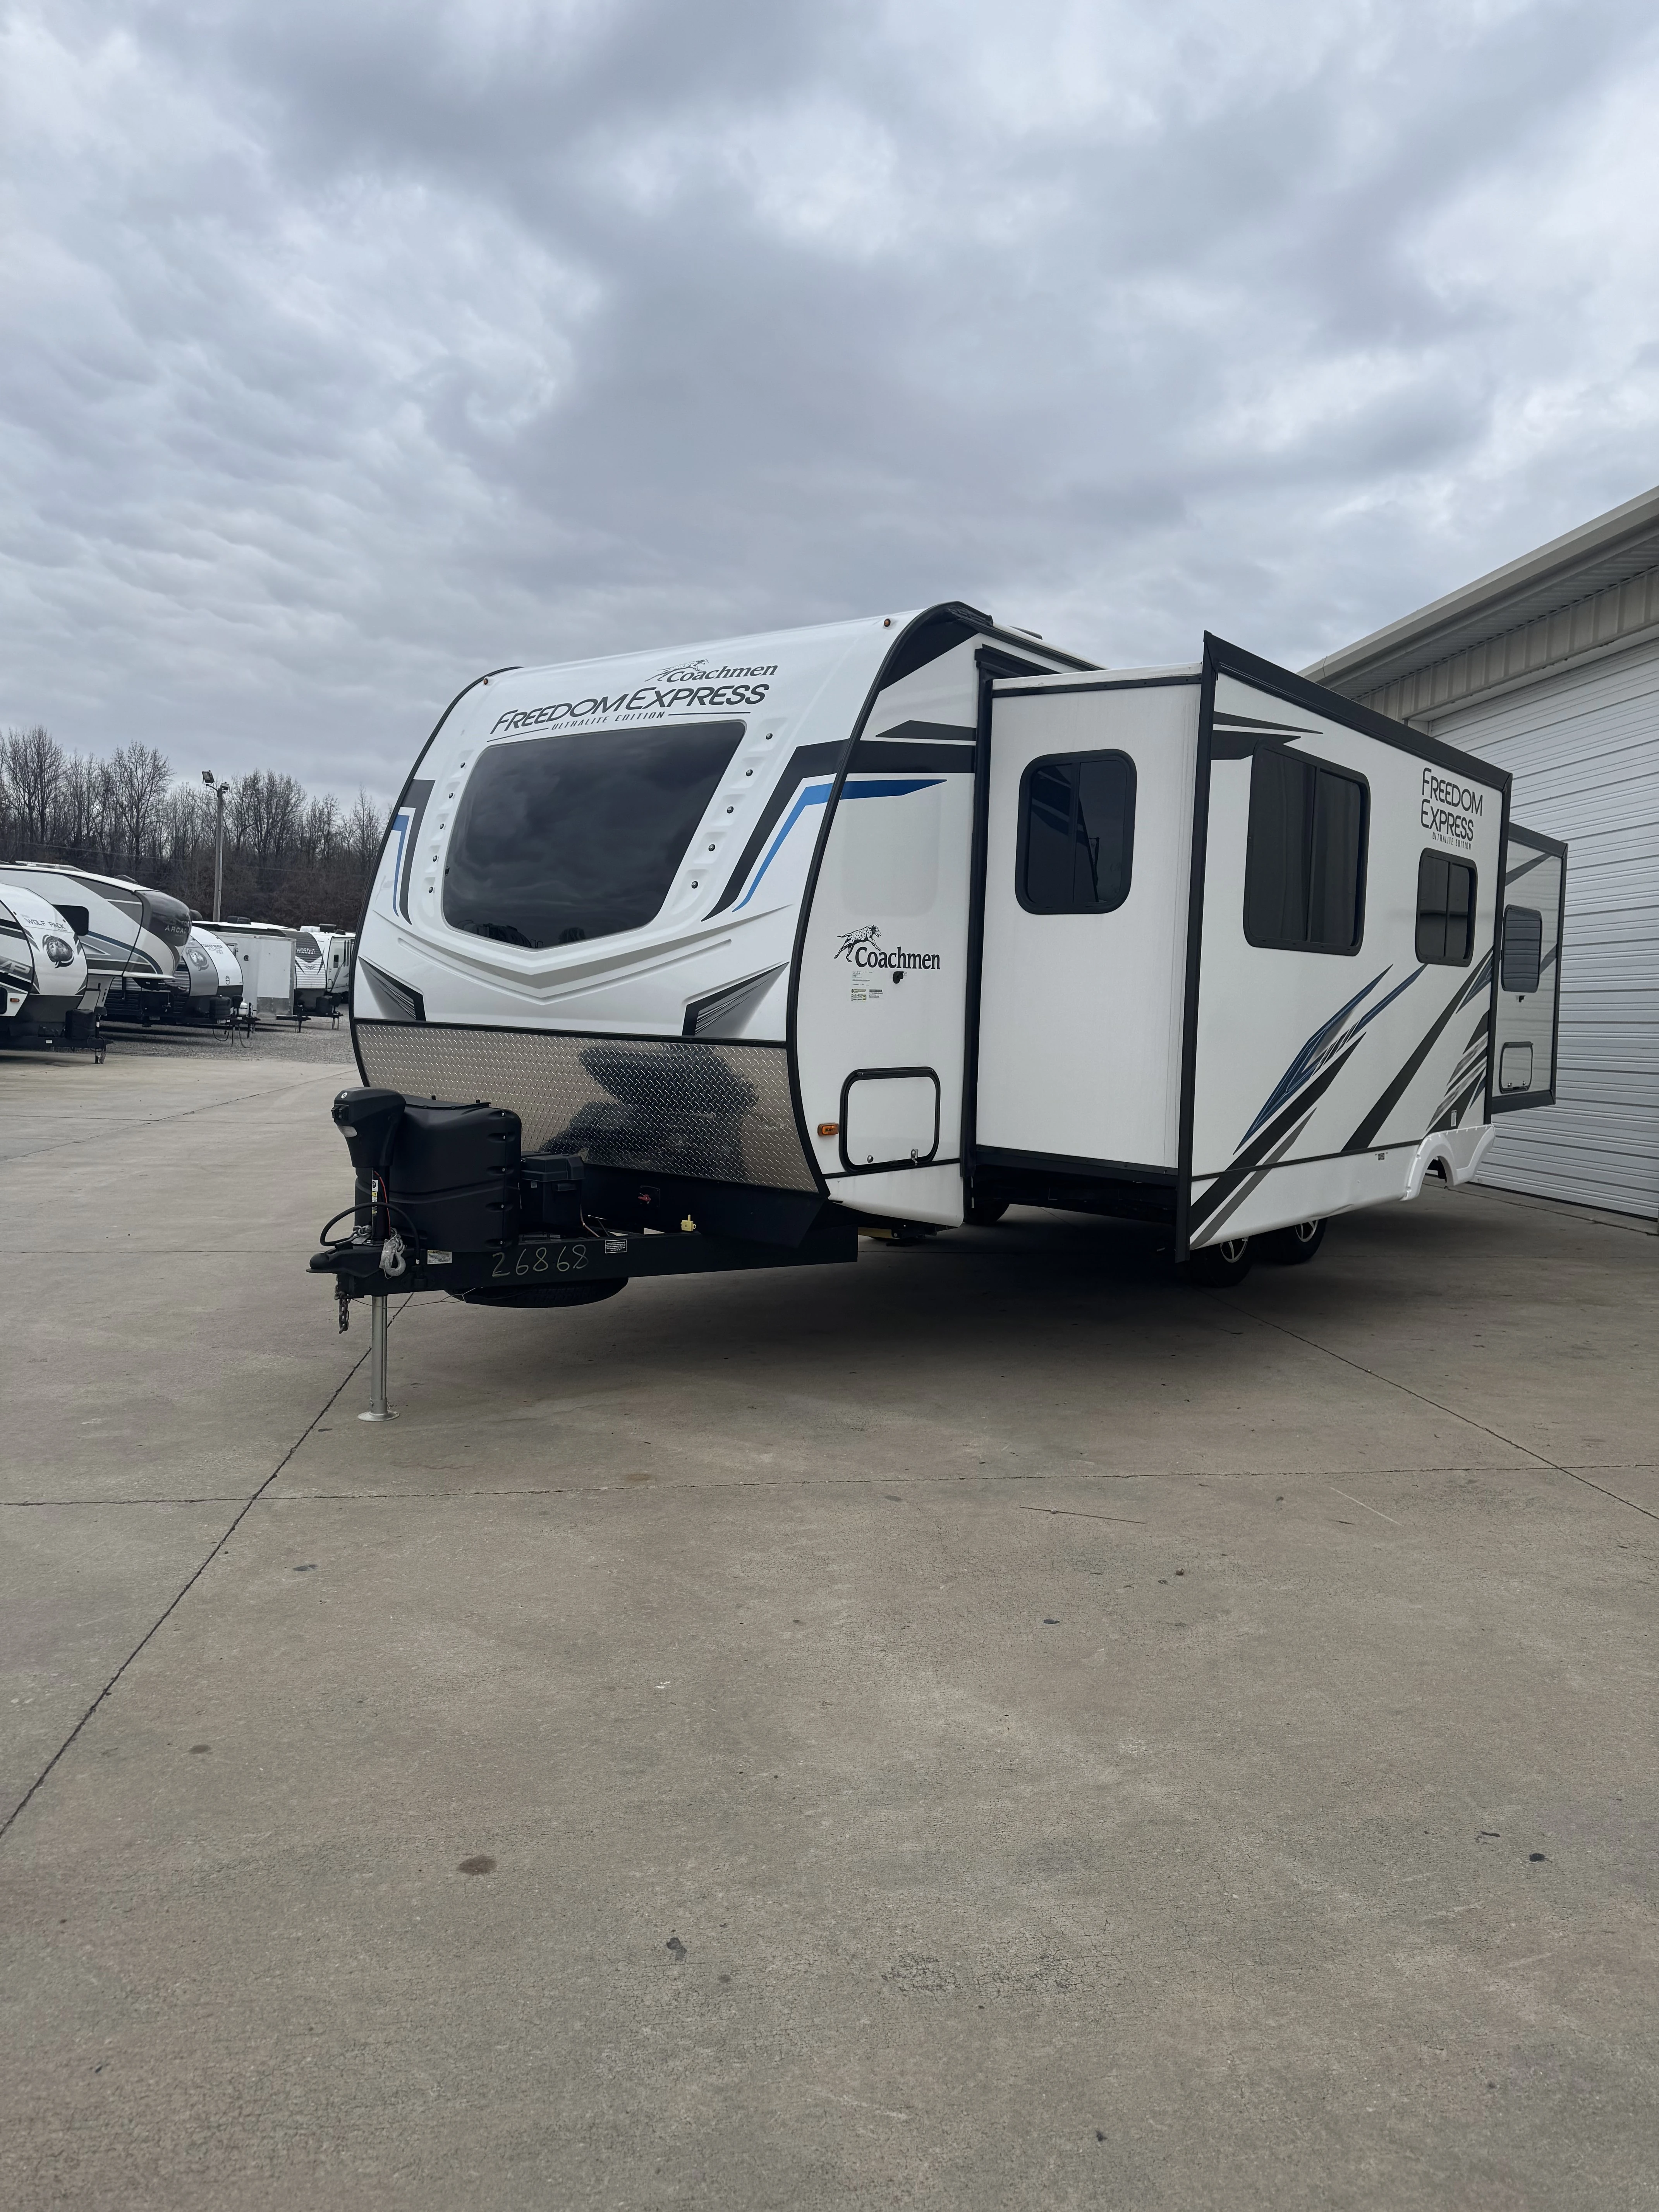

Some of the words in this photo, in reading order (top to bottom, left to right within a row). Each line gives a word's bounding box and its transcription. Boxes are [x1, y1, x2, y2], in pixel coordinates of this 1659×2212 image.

[666, 665, 778, 683] Coachmen
[551, 716, 610, 730] ULTRALITE
[614, 711, 665, 721] EDITION
[1422, 767, 1483, 816] FREEDOM
[1421, 799, 1474, 841] EXPRESS
[1432, 832, 1453, 845] ULTRALITE
[1455, 839, 1471, 850] EDITION
[24, 917, 46, 926] WOLF
[48, 921, 66, 929] PACK
[855, 946, 941, 970] Coachmen
[492, 1244, 589, 1277] 26868
